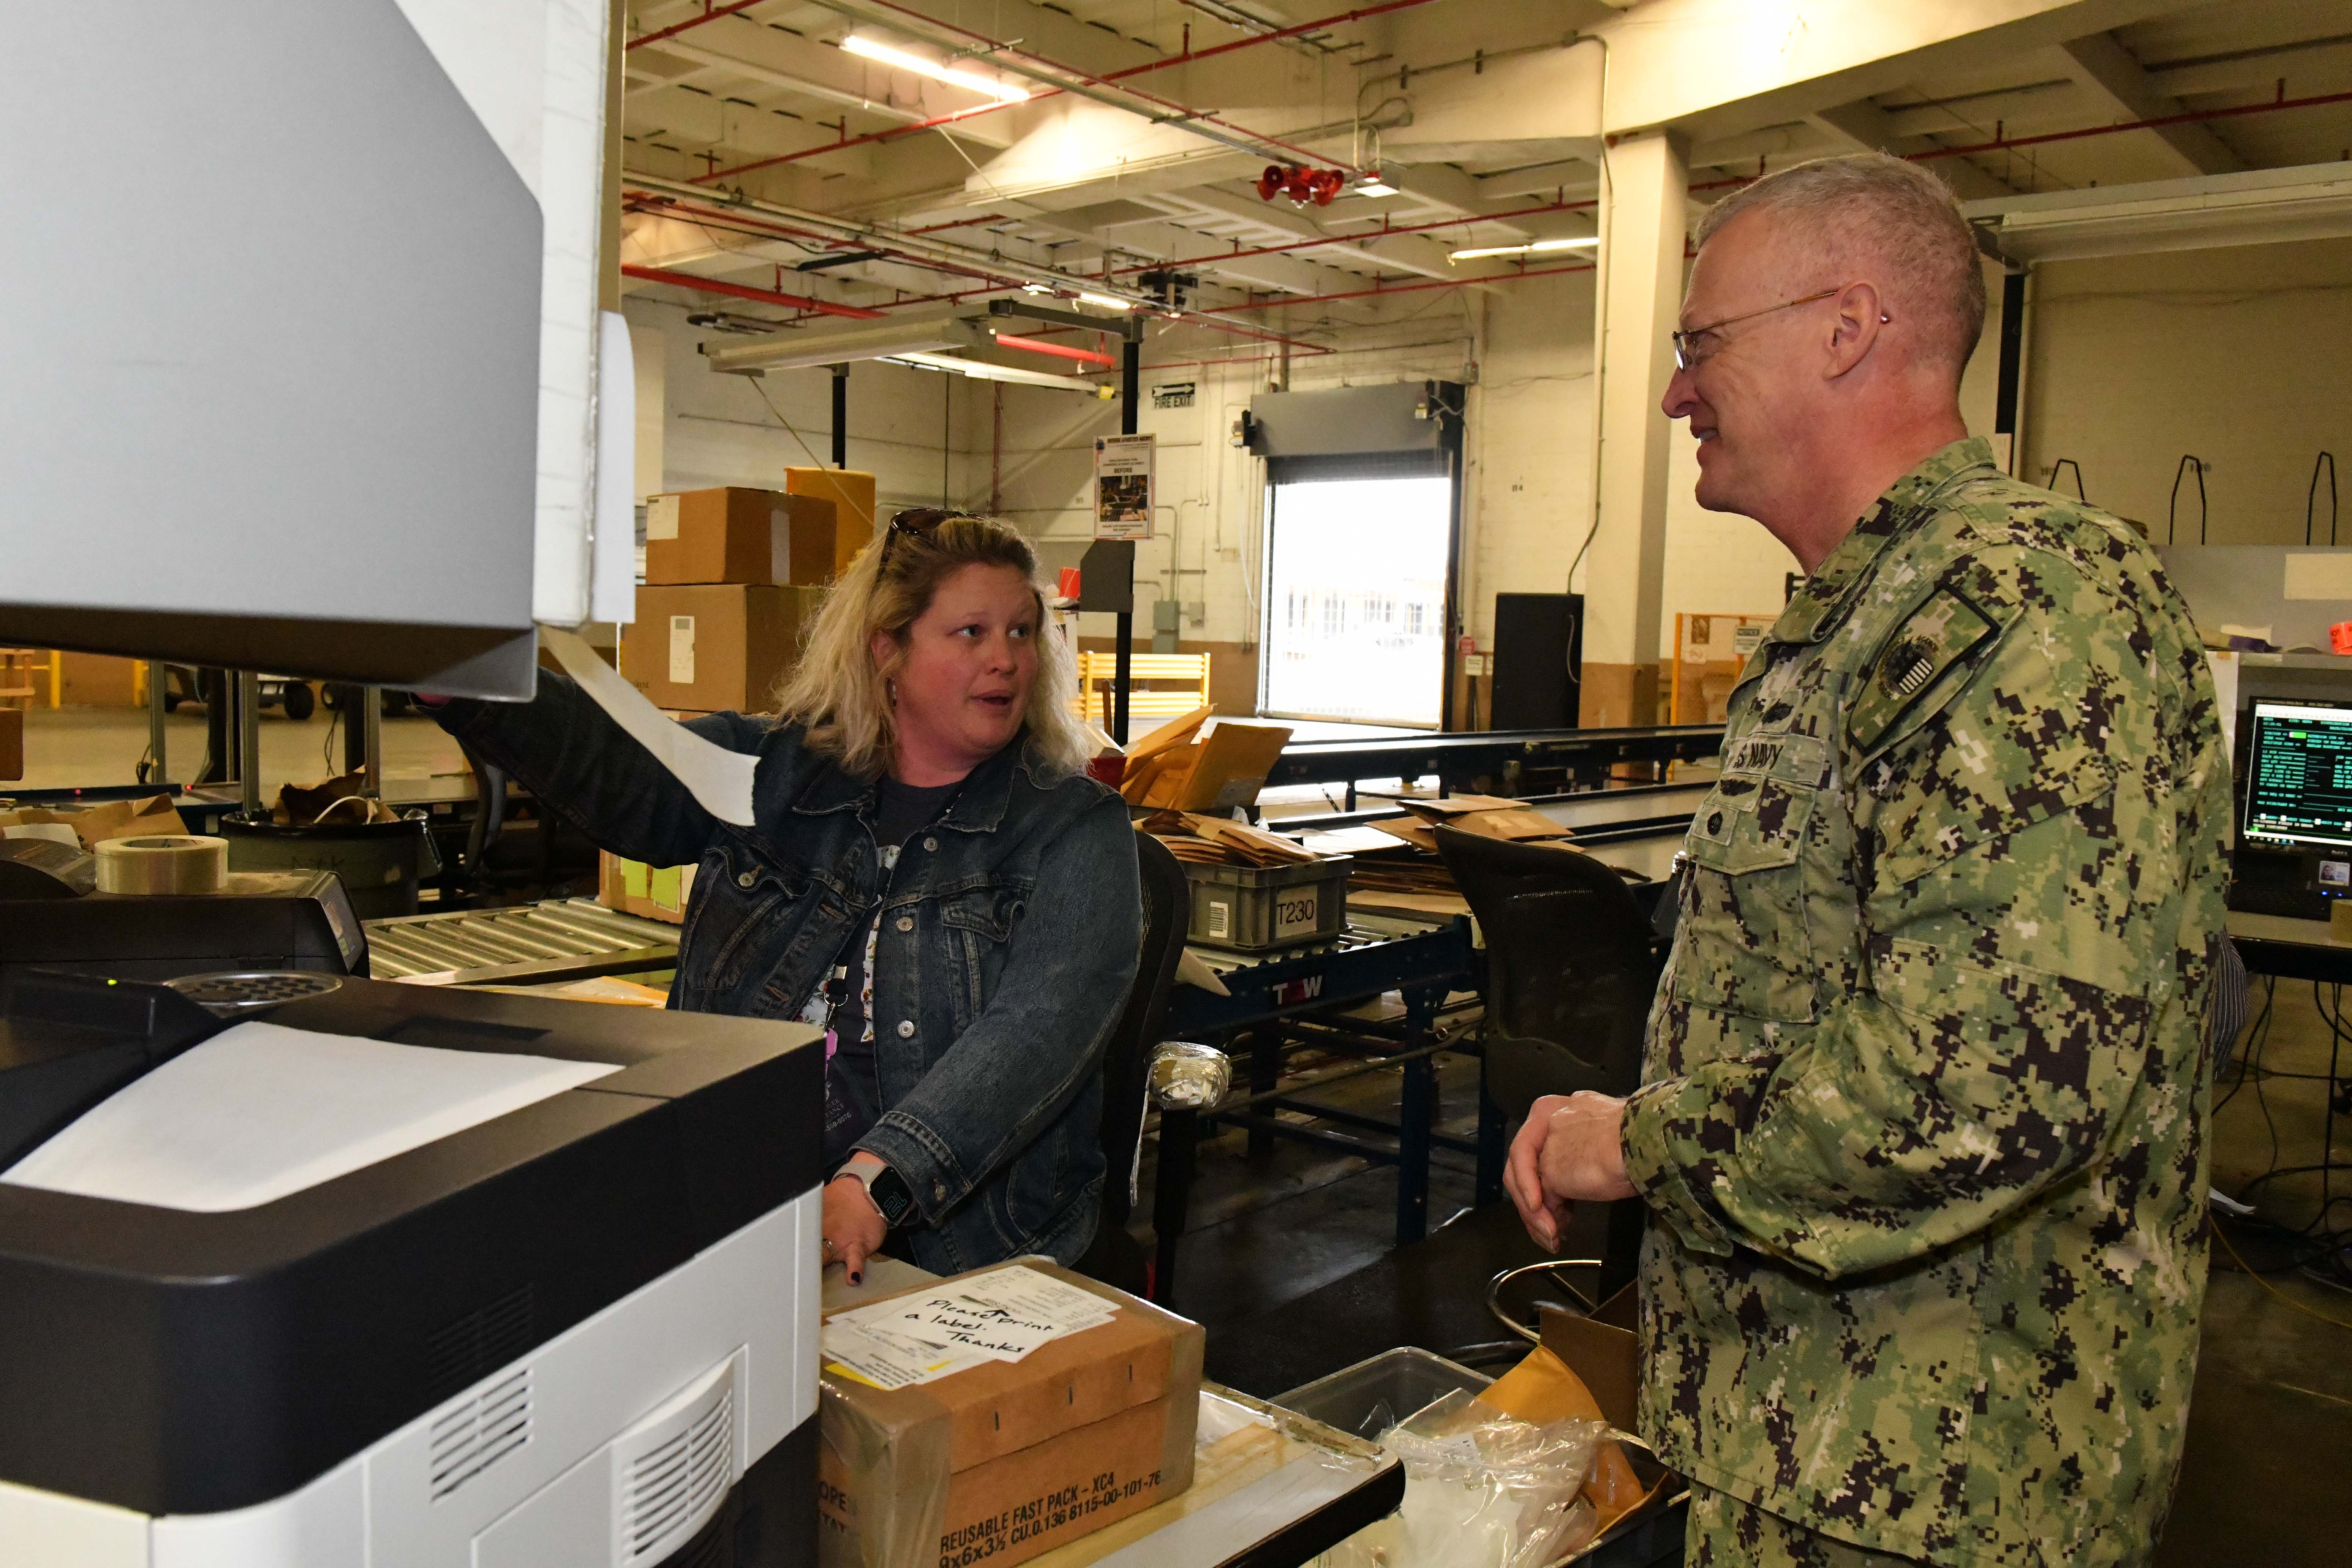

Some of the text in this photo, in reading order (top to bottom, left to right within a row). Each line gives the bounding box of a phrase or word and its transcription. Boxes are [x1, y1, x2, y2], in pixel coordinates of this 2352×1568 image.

[1154, 395, 1191, 408] FIRE EXIT
[1747, 743, 1784, 770] NAVY
[1277, 899, 1314, 925] T230
[926, 1300, 993, 1319] Please
[997, 1318, 1053, 1331] print
[946, 1331, 1024, 1353] Thanks
[940, 1511, 1008, 1555] REUSABLE
[1013, 1498, 1044, 1526] FAST
[1047, 1484, 1078, 1512] PACK
[1091, 1471, 1114, 1494] XC4
